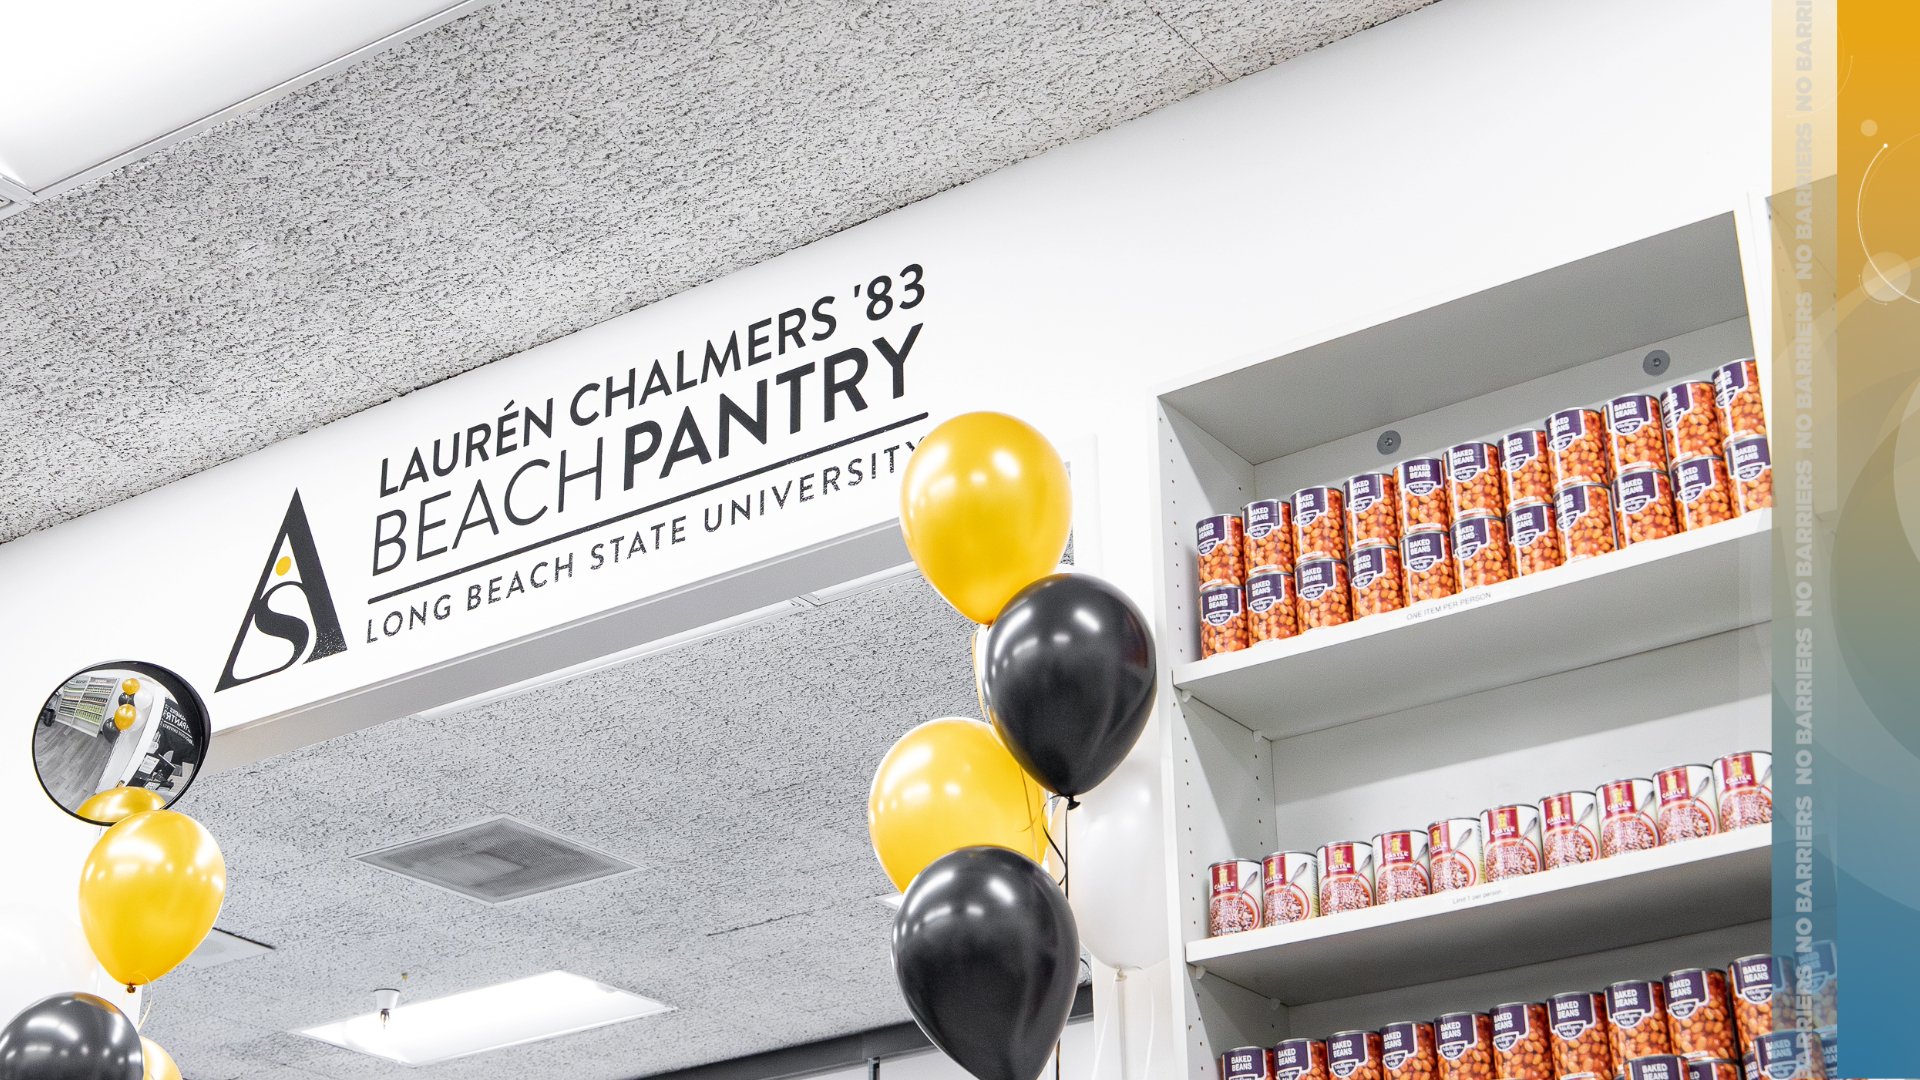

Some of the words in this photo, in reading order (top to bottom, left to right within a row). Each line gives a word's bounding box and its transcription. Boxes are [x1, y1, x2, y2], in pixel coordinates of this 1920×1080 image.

[380, 398, 553, 498] LAURÉN
[570, 296, 836, 426] CHALMERS
[853, 264, 925, 320] '83
[1614, 401, 1637, 411] BAKED
[1615, 408, 1638, 418] BEANS
[373, 437, 603, 576] BEACH
[624, 323, 923, 491] PANTRY
[1453, 449, 1474, 458] BAKED
[1735, 445, 1757, 456] BAKED
[1453, 456, 1474, 465] BEANS
[1736, 452, 1759, 464] BEANS
[1409, 464, 1431, 473] BAKED
[1409, 471, 1431, 479] BEANS
[1409, 539, 1430, 549] BAKED
[1410, 546, 1431, 556] BEANS
[1302, 567, 1321, 577] BAKED
[367, 595, 451, 643] LONG
[468, 553, 573, 610] BEACH
[591, 516, 686, 569] STATE
[1302, 574, 1322, 583] BEANS
[1252, 580, 1270, 589] BAKED
[1252, 587, 1271, 596] BEANS
[1208, 593, 1228, 603] BAKED
[1209, 600, 1228, 609] BEANS
[1407, 611, 1422, 620] ONE
[1424, 606, 1441, 616] ITEM
[1443, 601, 1458, 611] PER
[1460, 592, 1491, 605] PERSON
[1742, 964, 1768, 975] BAKED
[1744, 972, 1769, 984] BEANS
[1669, 979, 1691, 990] BAKED
[1614, 989, 1637, 1000] BAKED
[1670, 986, 1692, 998] BEANS
[1556, 1001, 1579, 1012] BAKED
[1615, 997, 1638, 1008] BEANS
[1494, 1012, 1512, 1023] BAKED
[1557, 1009, 1580, 1019] BEANS
[1440, 1022, 1461, 1031] BAKED
[1495, 1020, 1513, 1031] BEANS
[1383, 1031, 1401, 1042] BAKED
[1441, 1030, 1462, 1039] BEANS
[1332, 1040, 1352, 1050] BAKED
[1384, 1039, 1402, 1049] BEANS
[1765, 1039, 1791, 1050] BAKED
[1278, 1048, 1296, 1058] BAKED
[1333, 1048, 1352, 1058] BEANS
[1767, 1048, 1792, 1059] BEANS
[1231, 1055, 1252, 1063] BAKED
[1279, 1056, 1296, 1066] BEANS
[1232, 1063, 1252, 1071] BEANS
[1642, 1064, 1667, 1073] BAKED
[1644, 1070, 1668, 1080] BEANS
